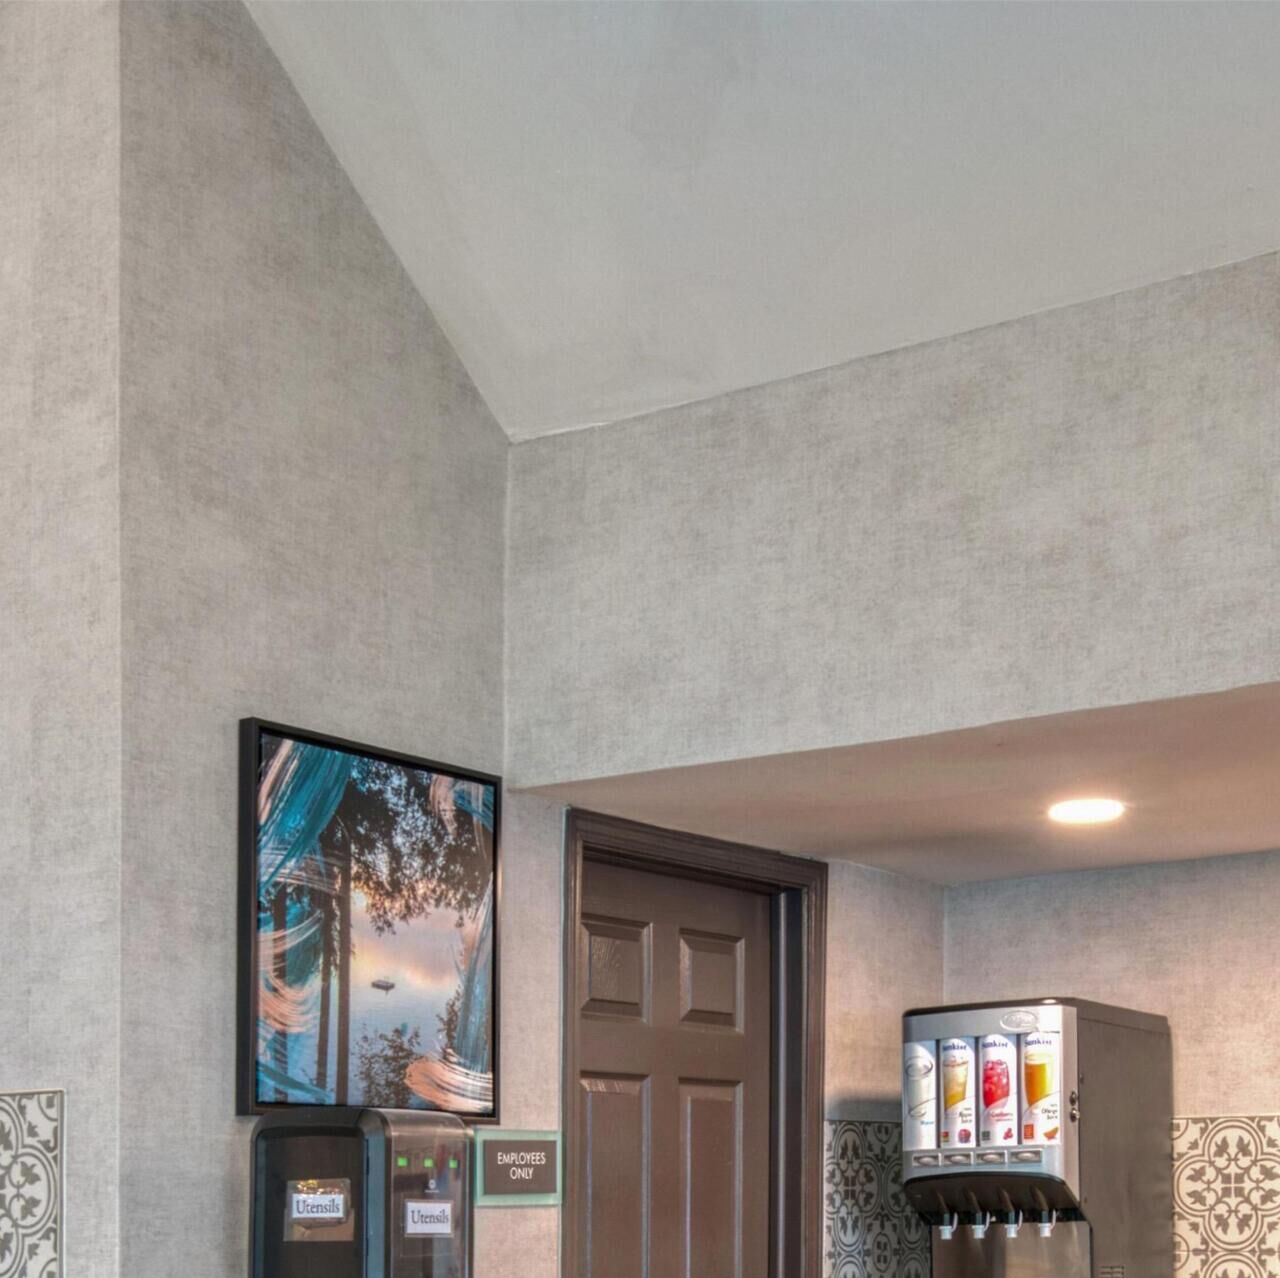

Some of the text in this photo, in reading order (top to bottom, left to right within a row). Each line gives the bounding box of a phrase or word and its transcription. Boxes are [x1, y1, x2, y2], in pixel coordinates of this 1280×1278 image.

[497, 1152, 546, 1165] EMPLOYEES
[509, 1167, 534, 1179] ONLY
[296, 1198, 340, 1215] Utensils
[411, 1209, 449, 1225] Utensils
